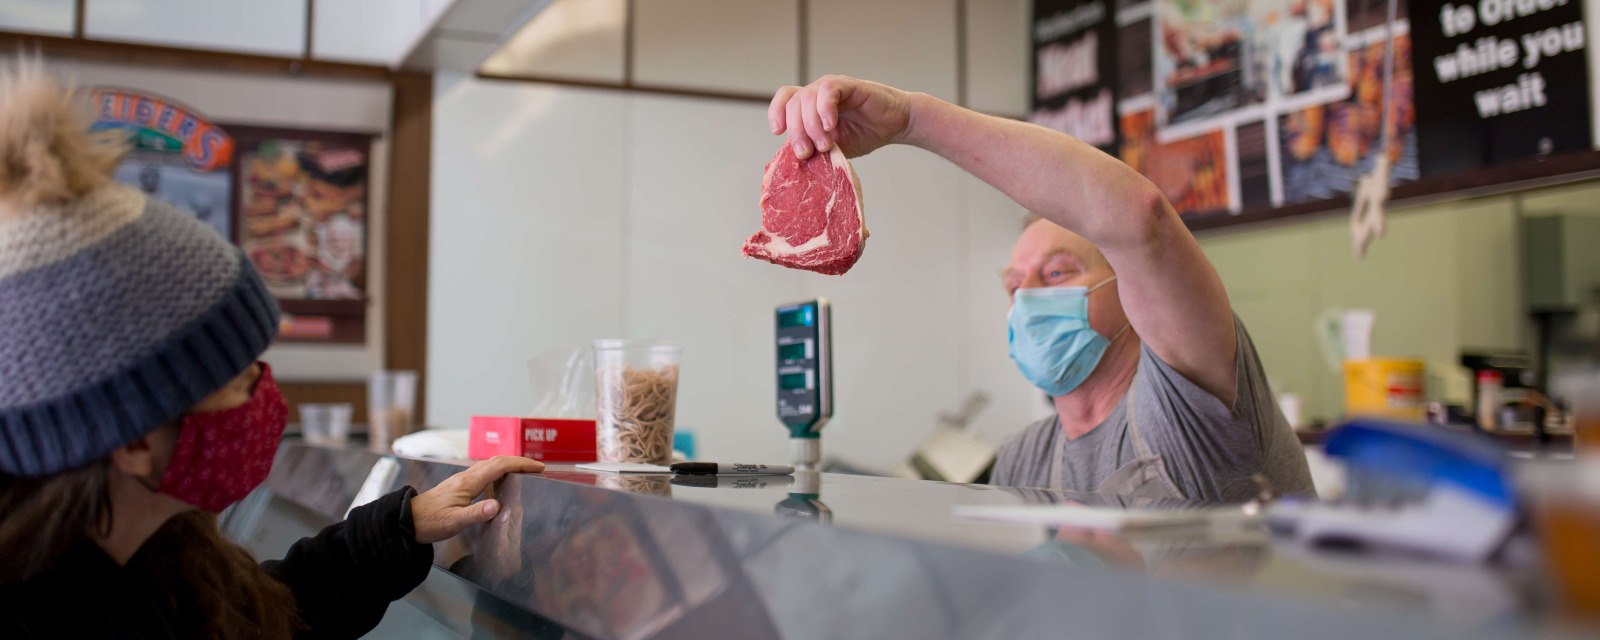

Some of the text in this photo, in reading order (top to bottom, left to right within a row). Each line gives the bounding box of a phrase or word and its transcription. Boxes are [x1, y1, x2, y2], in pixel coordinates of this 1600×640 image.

[1440, 3, 1476, 37] to
[1433, 21, 1585, 83] while you
[1474, 72, 1547, 118] wait
[95, 91, 229, 172] EIDERS
[525, 428, 557, 441] PICK UP
